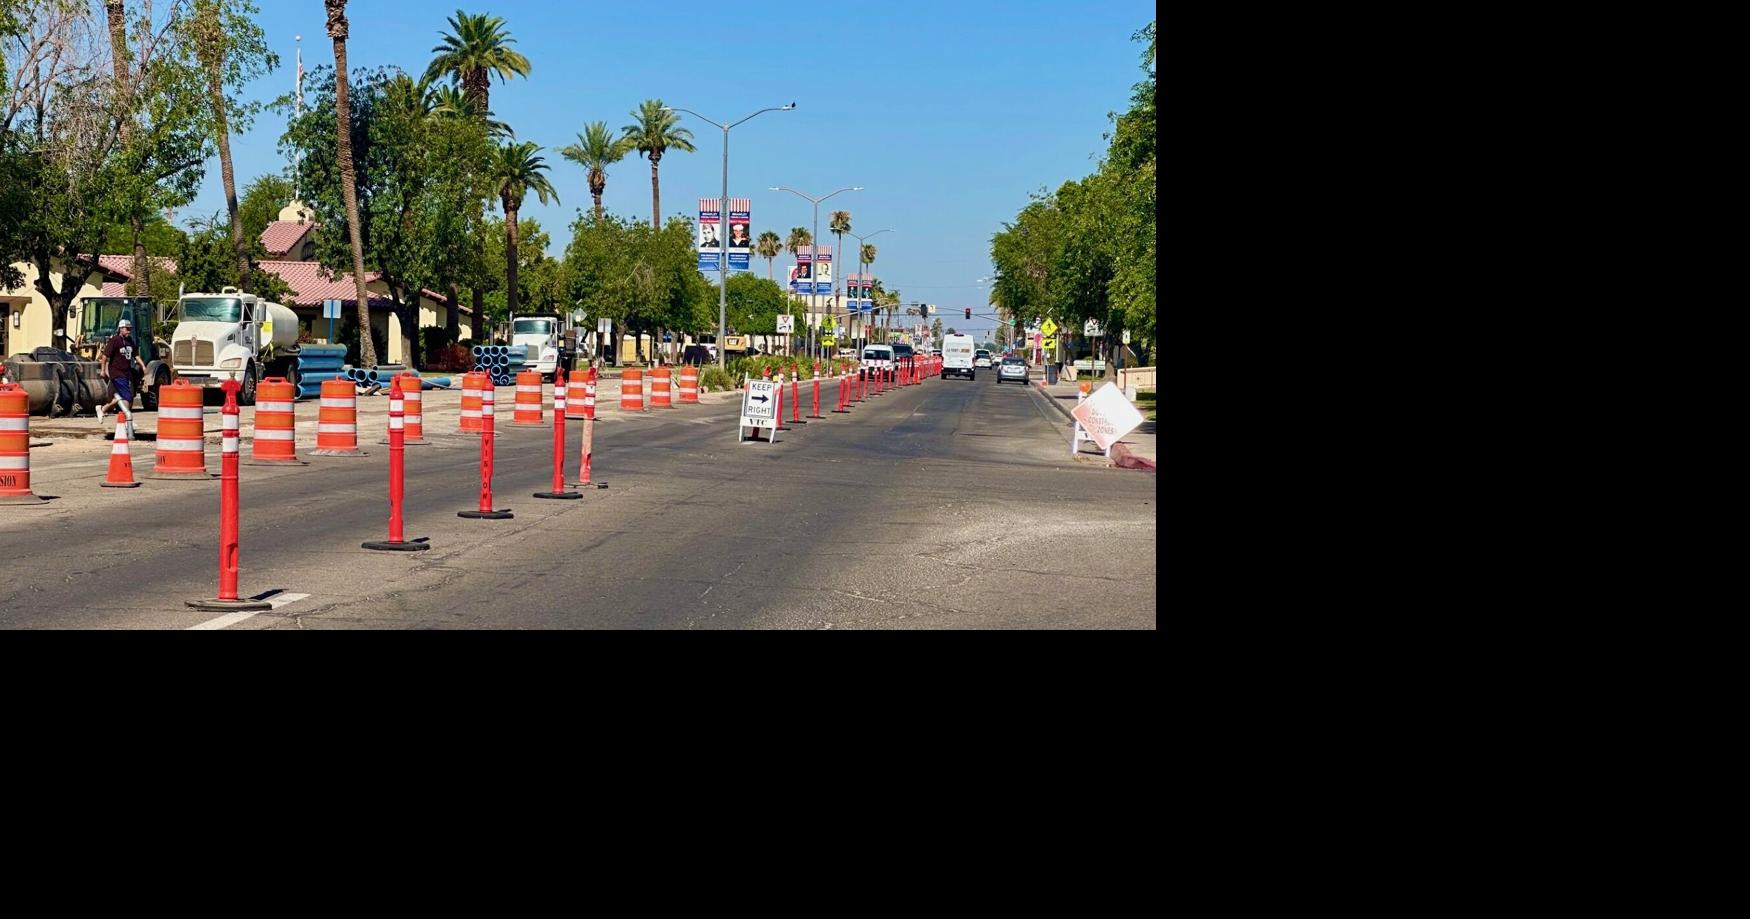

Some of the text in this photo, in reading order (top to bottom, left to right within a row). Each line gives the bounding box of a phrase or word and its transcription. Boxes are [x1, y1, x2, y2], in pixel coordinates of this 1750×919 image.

[752, 383, 772, 391] KEEP
[748, 406, 771, 415] RIGHT
[749, 418, 768, 426] VTC
